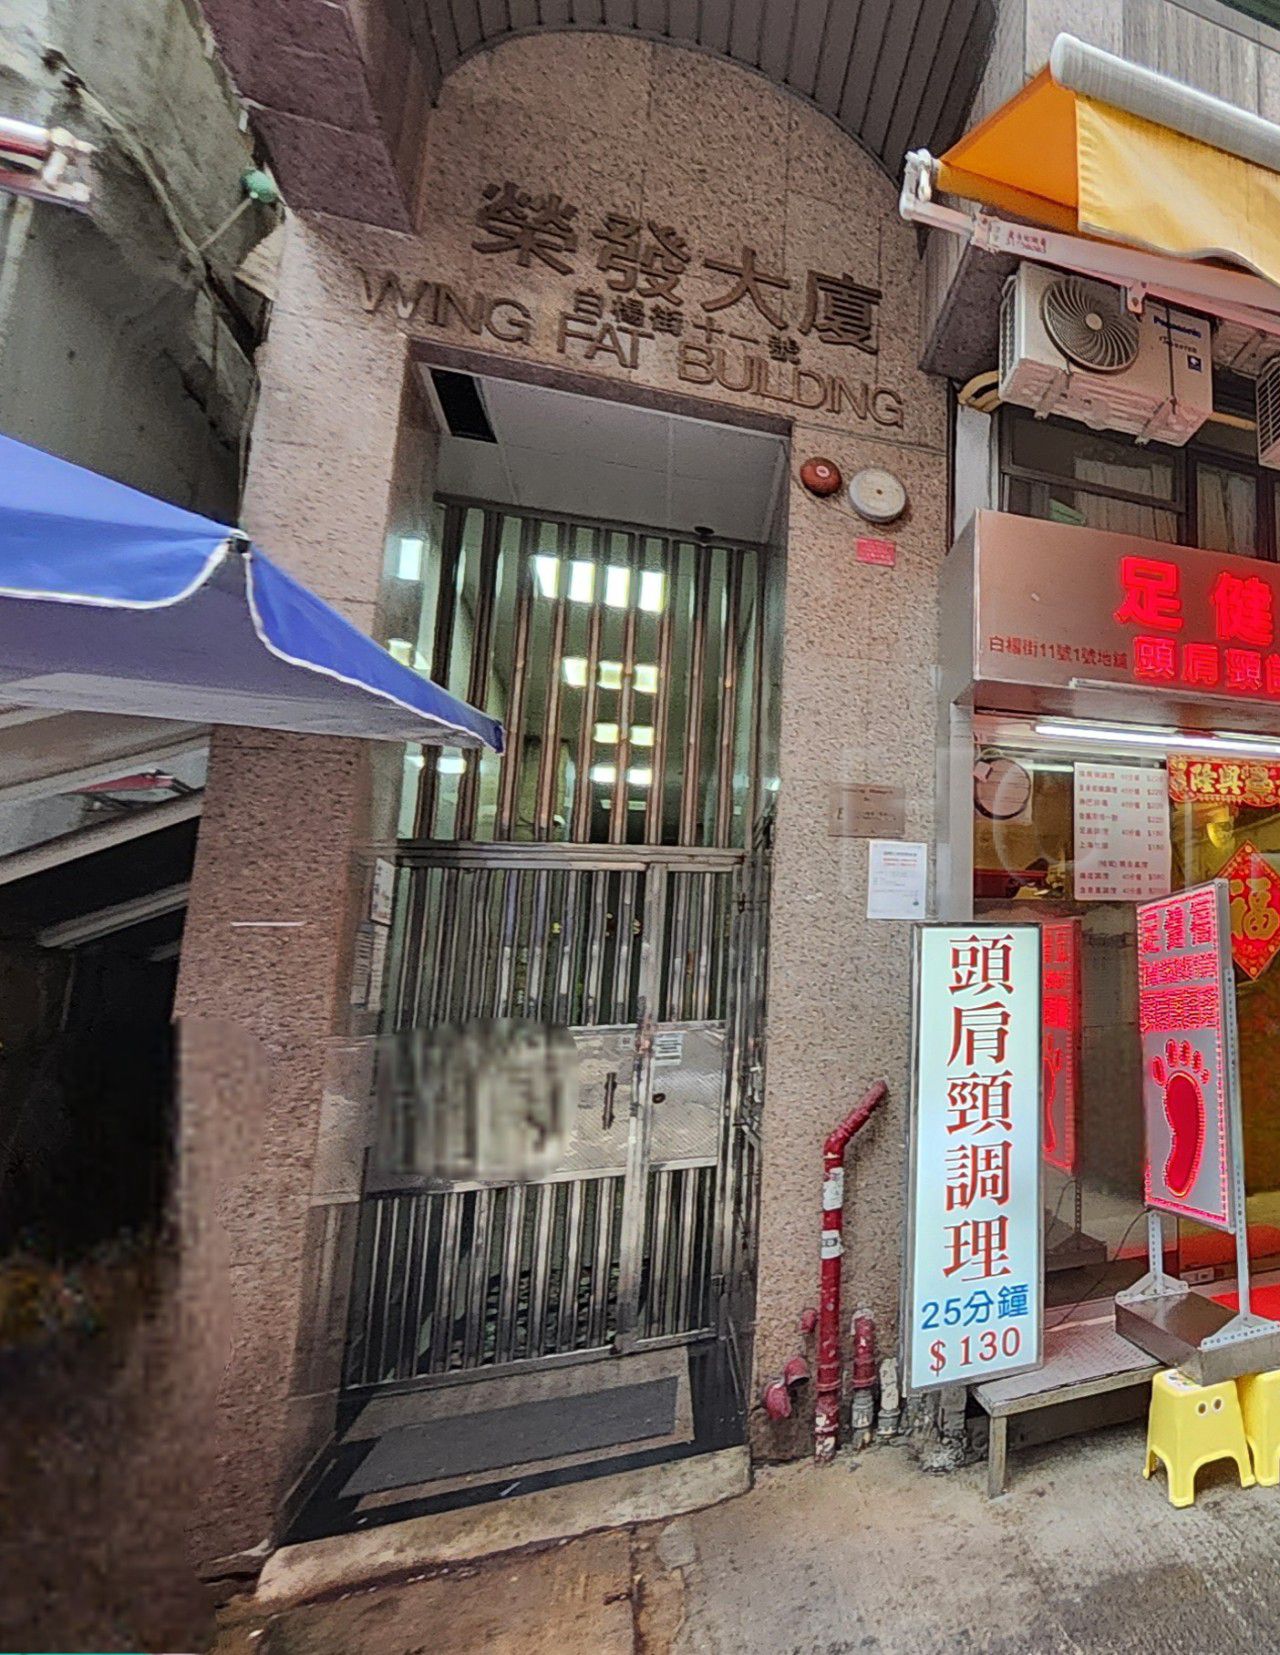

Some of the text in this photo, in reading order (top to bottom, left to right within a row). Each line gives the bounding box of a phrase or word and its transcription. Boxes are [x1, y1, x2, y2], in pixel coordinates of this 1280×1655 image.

[356, 265, 905, 429] WING FAT BUILDING
[471, 180, 882, 355] 榮發大廈
[1230, 877, 1280, 940] 福
[943, 933, 1015, 1283] 頭肩頸調理
[921, 1283, 1029, 1331] 25分鐘
